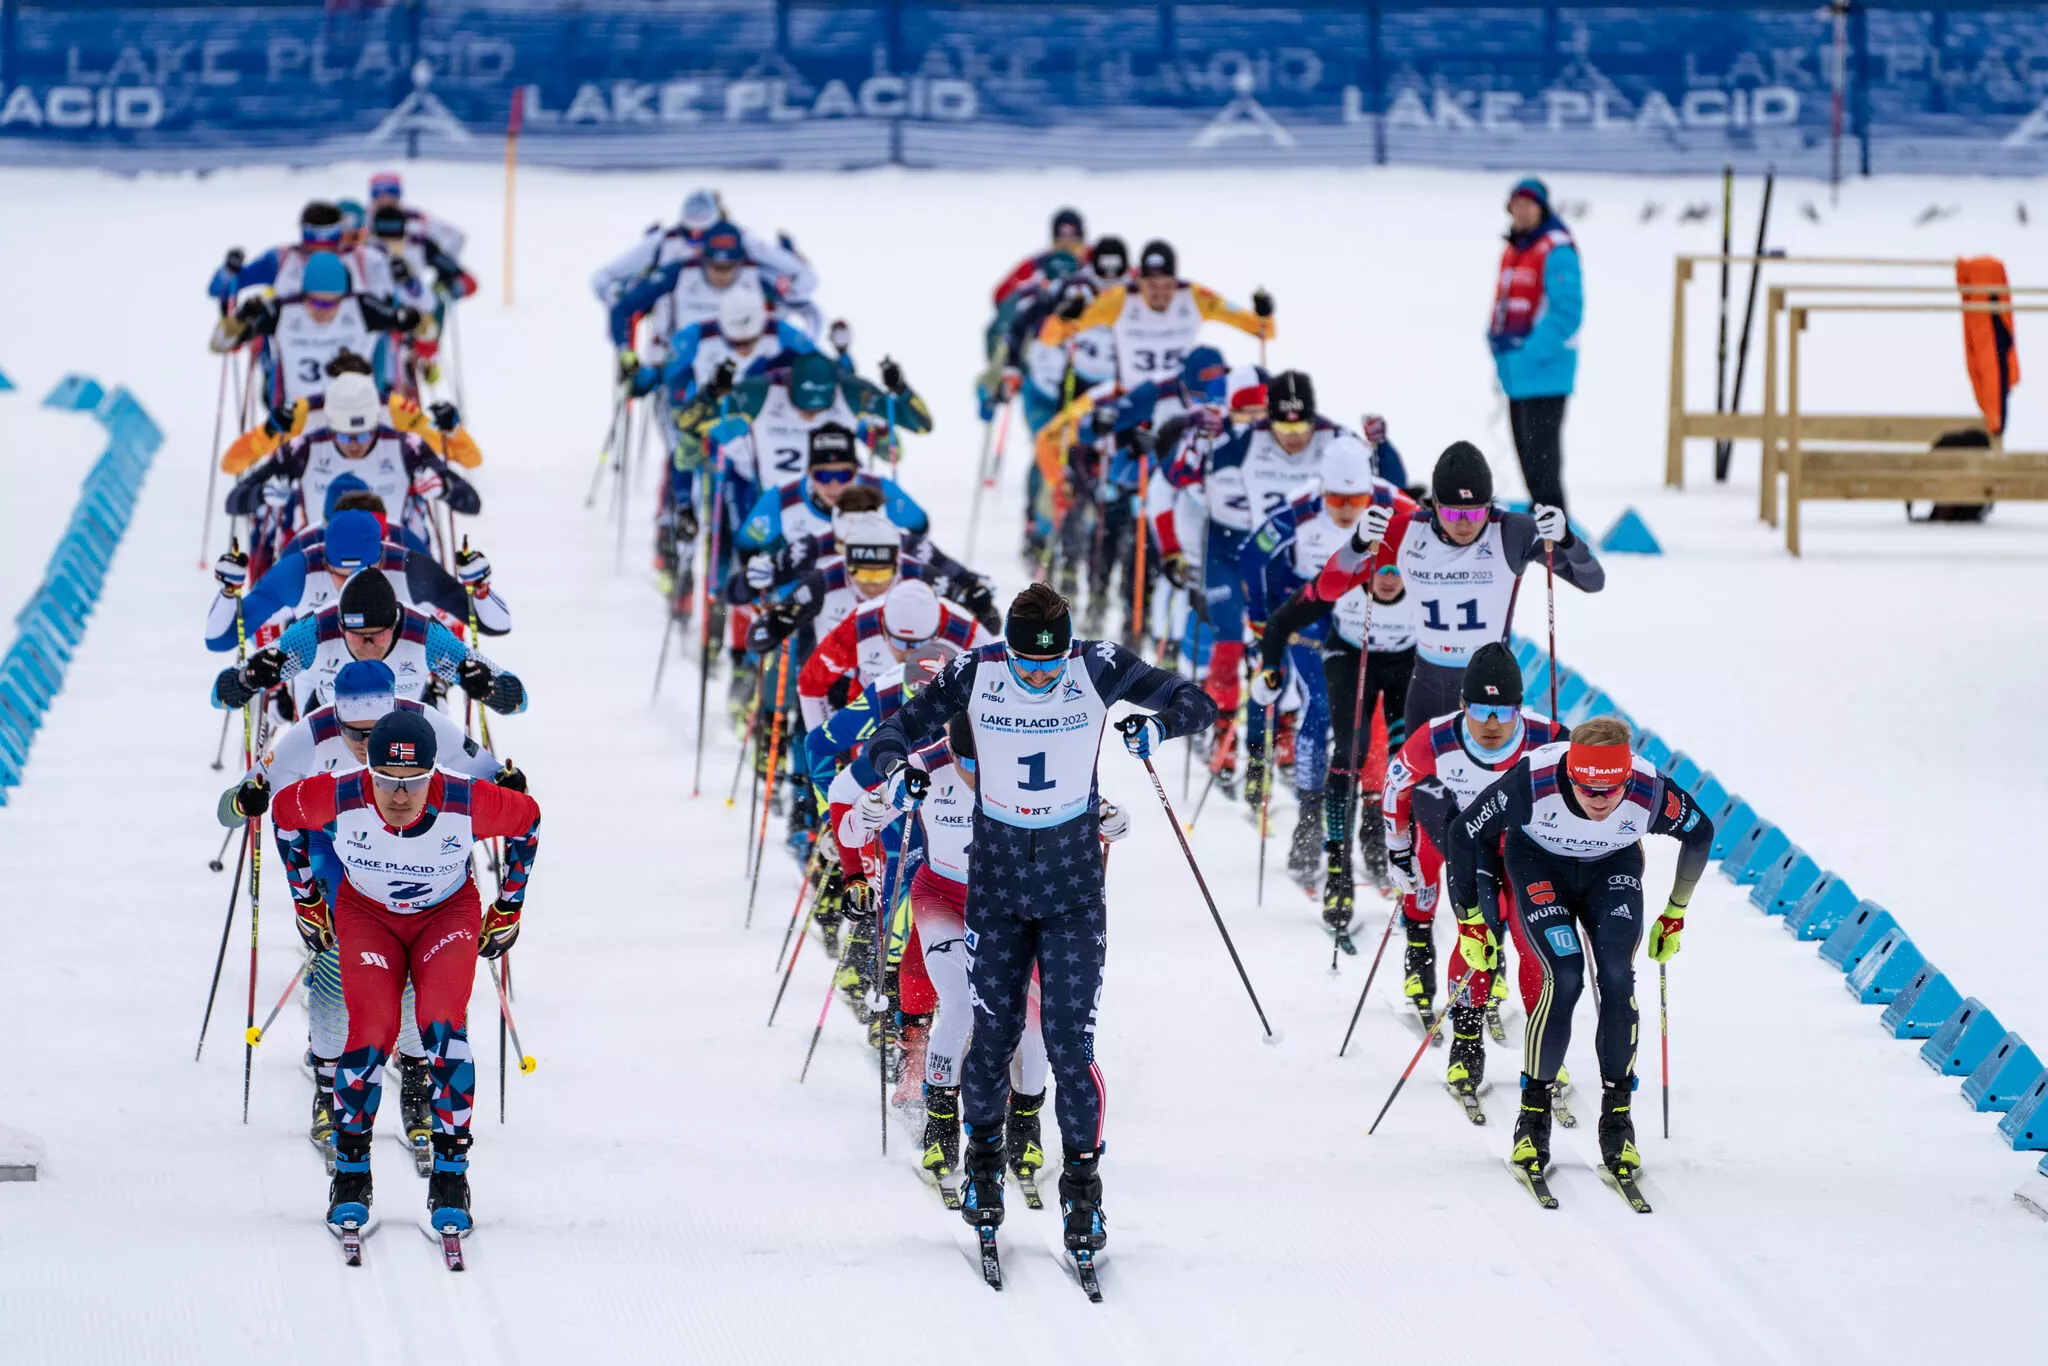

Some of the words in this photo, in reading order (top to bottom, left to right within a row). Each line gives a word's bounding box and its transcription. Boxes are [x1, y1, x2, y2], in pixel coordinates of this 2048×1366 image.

[0, 85, 164, 129] ACID
[524, 83, 699, 123] LAKE
[725, 77, 979, 121] PLACID
[1343, 84, 1523, 130] LAKE
[1548, 86, 1800, 130] PLACID
[298, 357, 321, 384] 3
[774, 447, 802, 472] 2
[851, 547, 876, 560] ITA
[1408, 568, 1433, 579] LAKE
[1433, 571, 1470, 580] PLACID
[1472, 571, 1493, 580] 2023
[1421, 599, 1487, 631] 11
[1042, 635, 1049, 643] D
[981, 692, 1005, 703] FISU
[980, 713, 1012, 726] LAKE
[1015, 717, 1059, 728] PLACID
[1061, 712, 1088, 726] 2023
[1065, 721, 1089, 732] GAMES
[1017, 751, 1056, 791] 1
[1574, 765, 1623, 777] VIESSMANN
[1031, 806, 1052, 815] NY
[935, 815, 964, 824] LAKE
[1465, 802, 1493, 839] Audi
[346, 840, 371, 850] FISU
[1566, 838, 1609, 847] PLACID
[347, 855, 382, 869] LAKE
[385, 862, 435, 873] PLACID
[387, 880, 433, 900] 2
[411, 898, 432, 907] NY
[423, 930, 463, 963] CRAFT
[930, 1051, 952, 1065] SNOW
[929, 1061, 952, 1073] JAPAN
